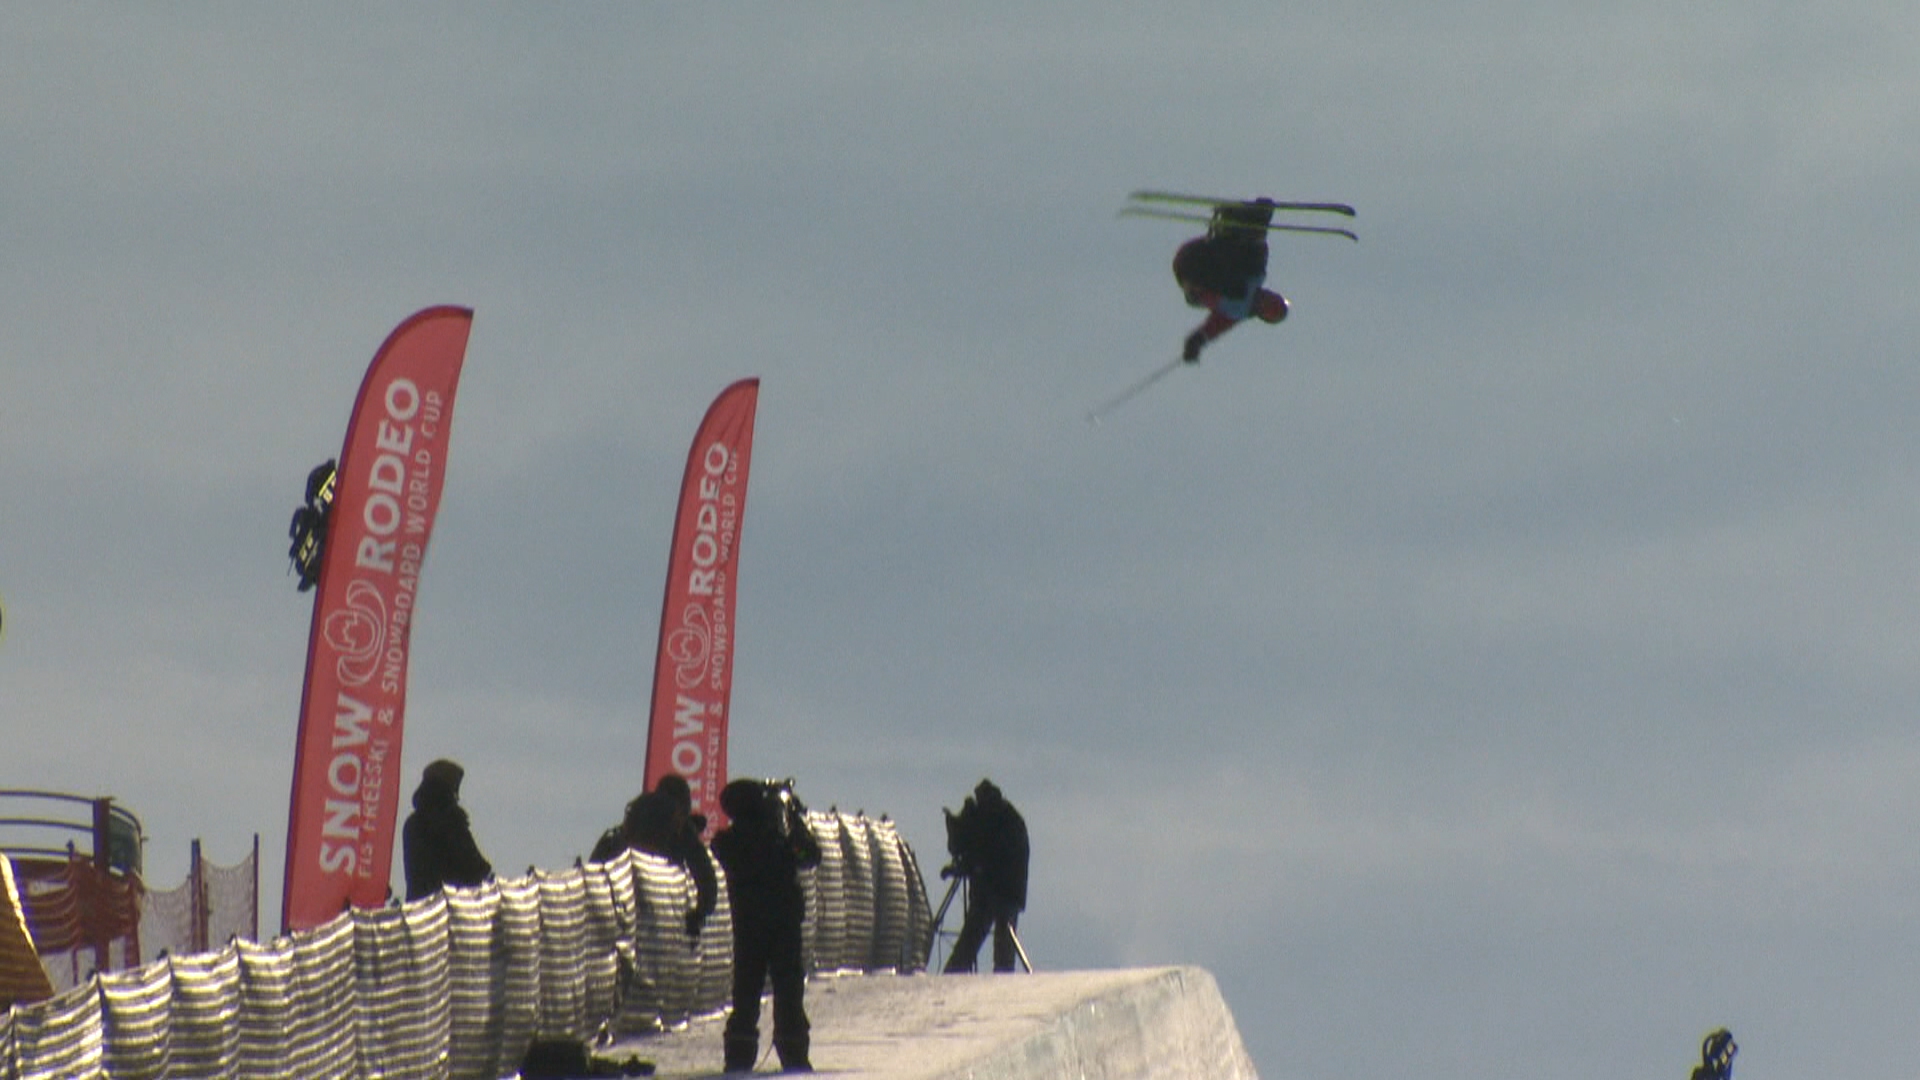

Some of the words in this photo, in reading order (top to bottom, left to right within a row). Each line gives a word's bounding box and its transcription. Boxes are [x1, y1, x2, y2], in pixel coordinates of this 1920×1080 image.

[421, 391, 443, 439] CUP
[405, 449, 432, 534] WORLD
[688, 442, 729, 596] RODEO
[319, 693, 373, 876] SNOW
[355, 377, 420, 574] RODEO
[381, 543, 421, 694] SNOWBOARD
[377, 708, 394, 725] &
